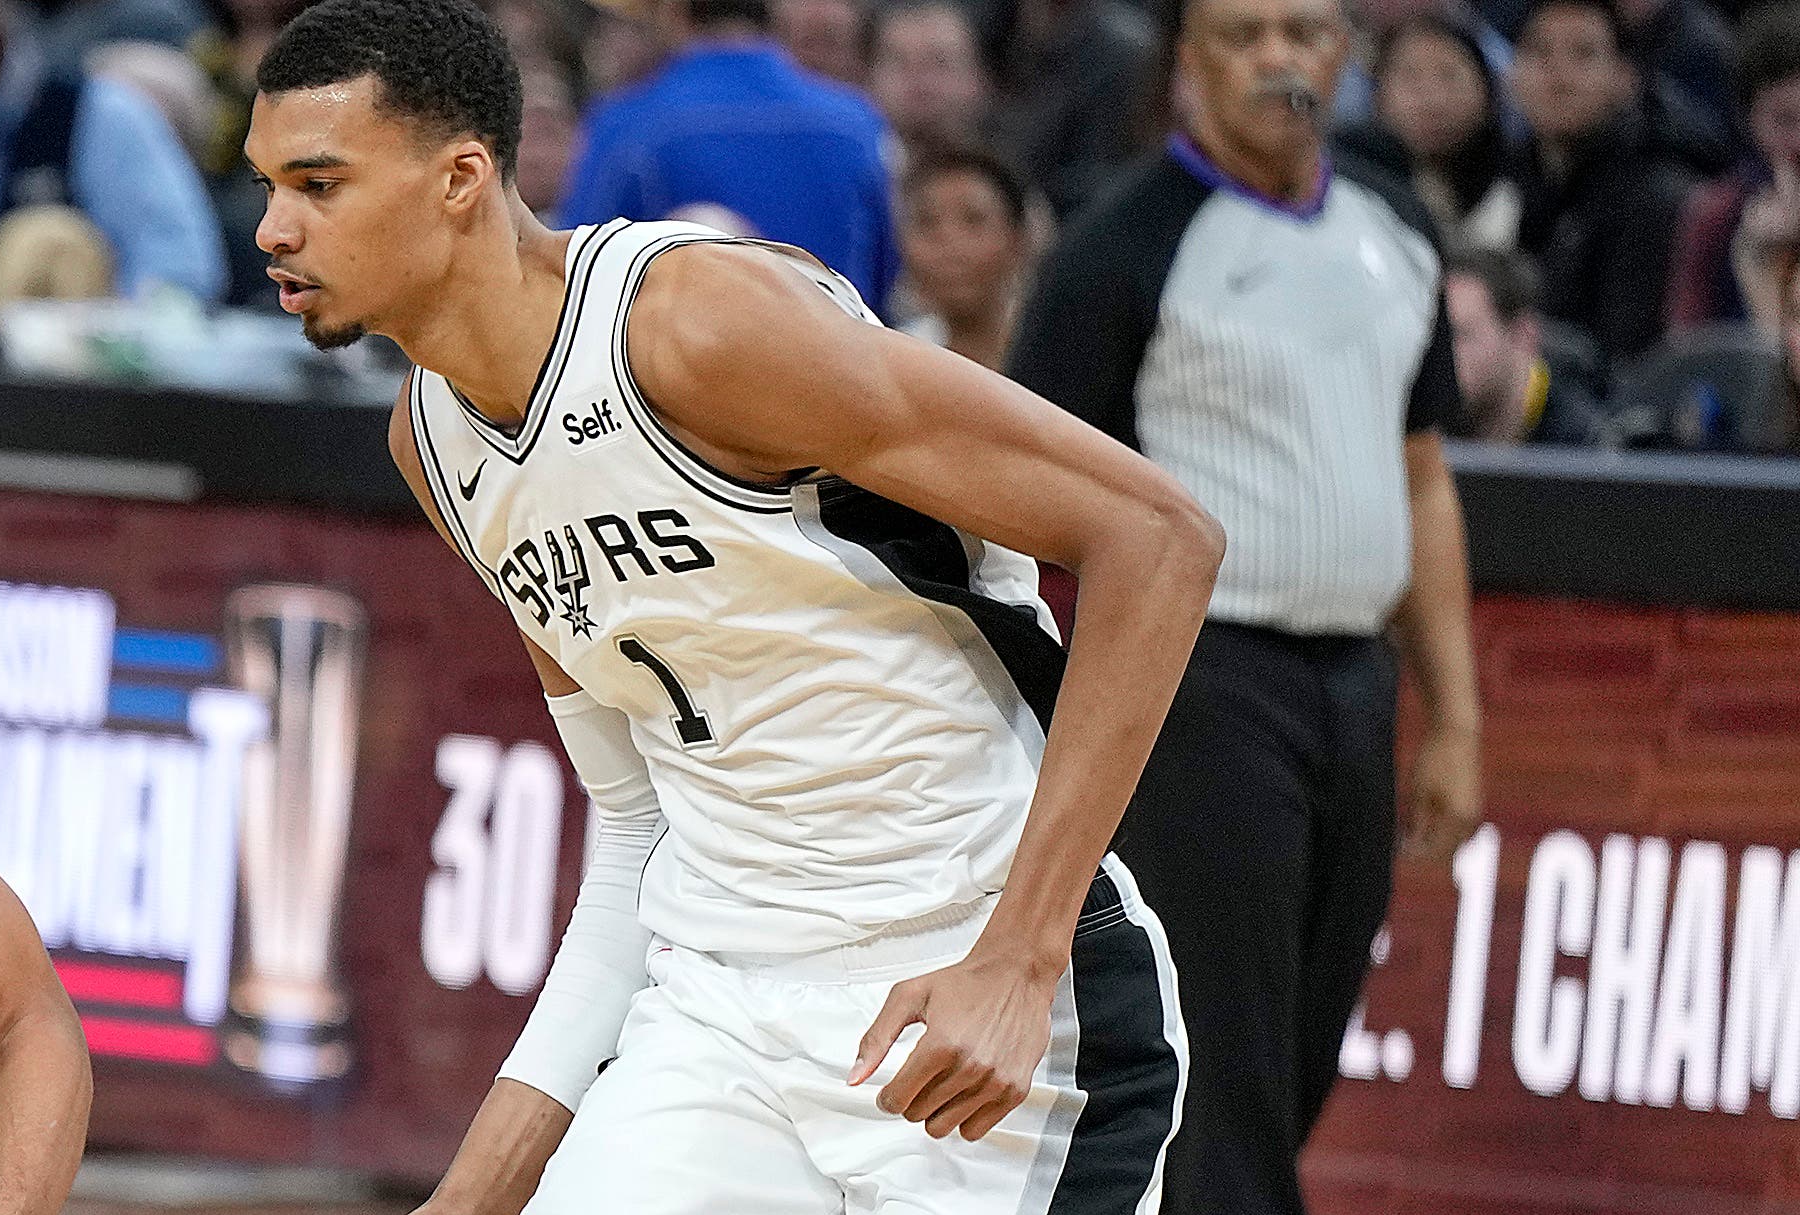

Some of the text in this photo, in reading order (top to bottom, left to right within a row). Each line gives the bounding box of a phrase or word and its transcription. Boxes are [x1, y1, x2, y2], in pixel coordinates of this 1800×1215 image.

[562, 398, 623, 446] Self.
[499, 508, 717, 642] SPURS
[611, 631, 719, 751] 1
[421, 734, 564, 996] 30
[1441, 822, 1501, 1090] 1
